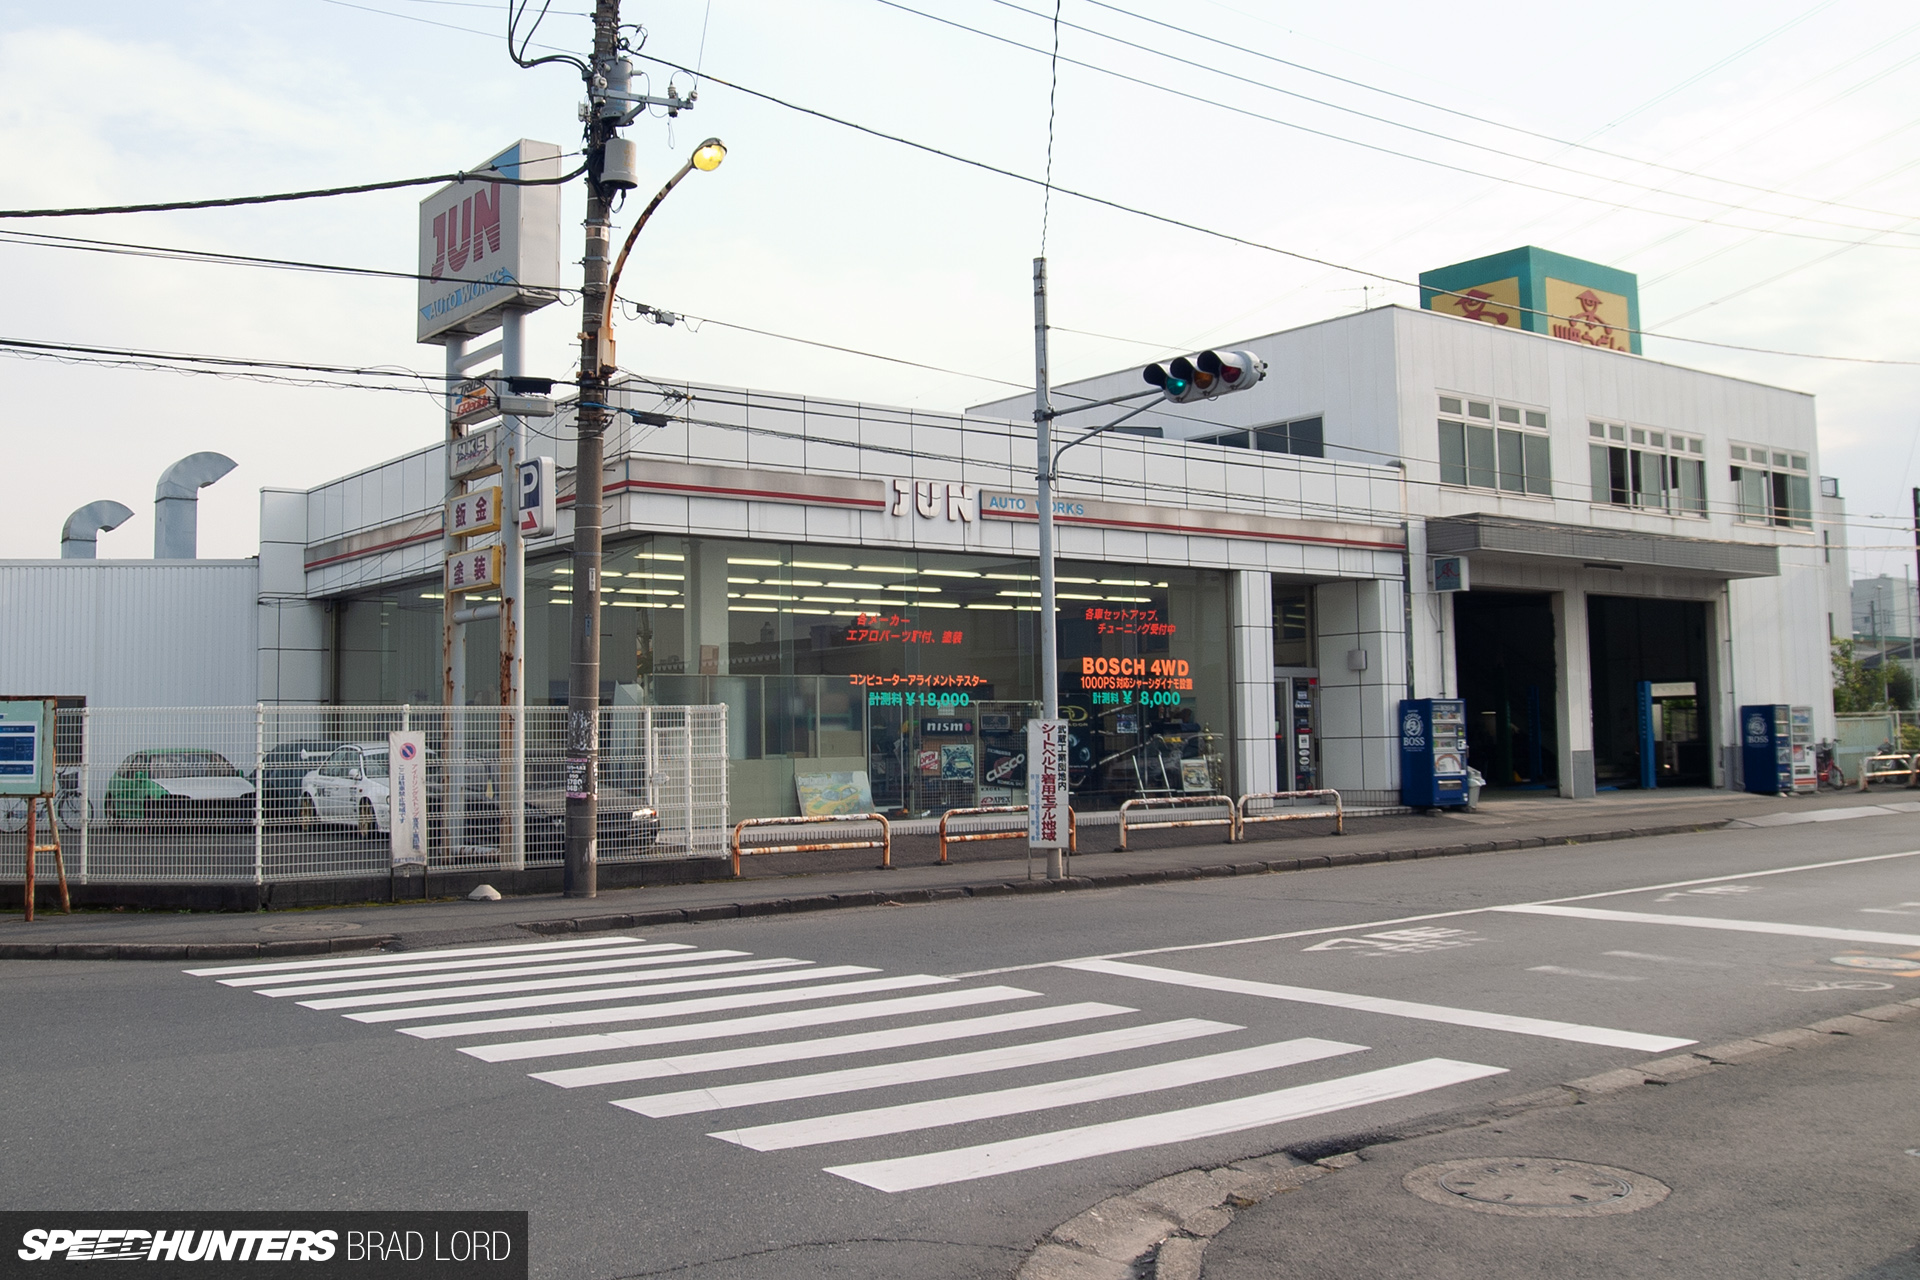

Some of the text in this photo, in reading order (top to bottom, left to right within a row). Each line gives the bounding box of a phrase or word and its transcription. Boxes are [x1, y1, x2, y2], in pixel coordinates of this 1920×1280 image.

[431, 181, 500, 284] JUN
[430, 292, 458, 319] AUTO
[457, 434, 487, 455] HKS
[892, 479, 973, 522] JUN
[990, 496, 1026, 510] AUTO
[1082, 657, 1190, 677] BOSCH 4WD
[868, 692, 902, 706] 計測料
[1092, 692, 1119, 705] 計測料
[1403, 737, 1425, 746] BOSS
[1041, 723, 1057, 842] シートベルト着用モデル地域
